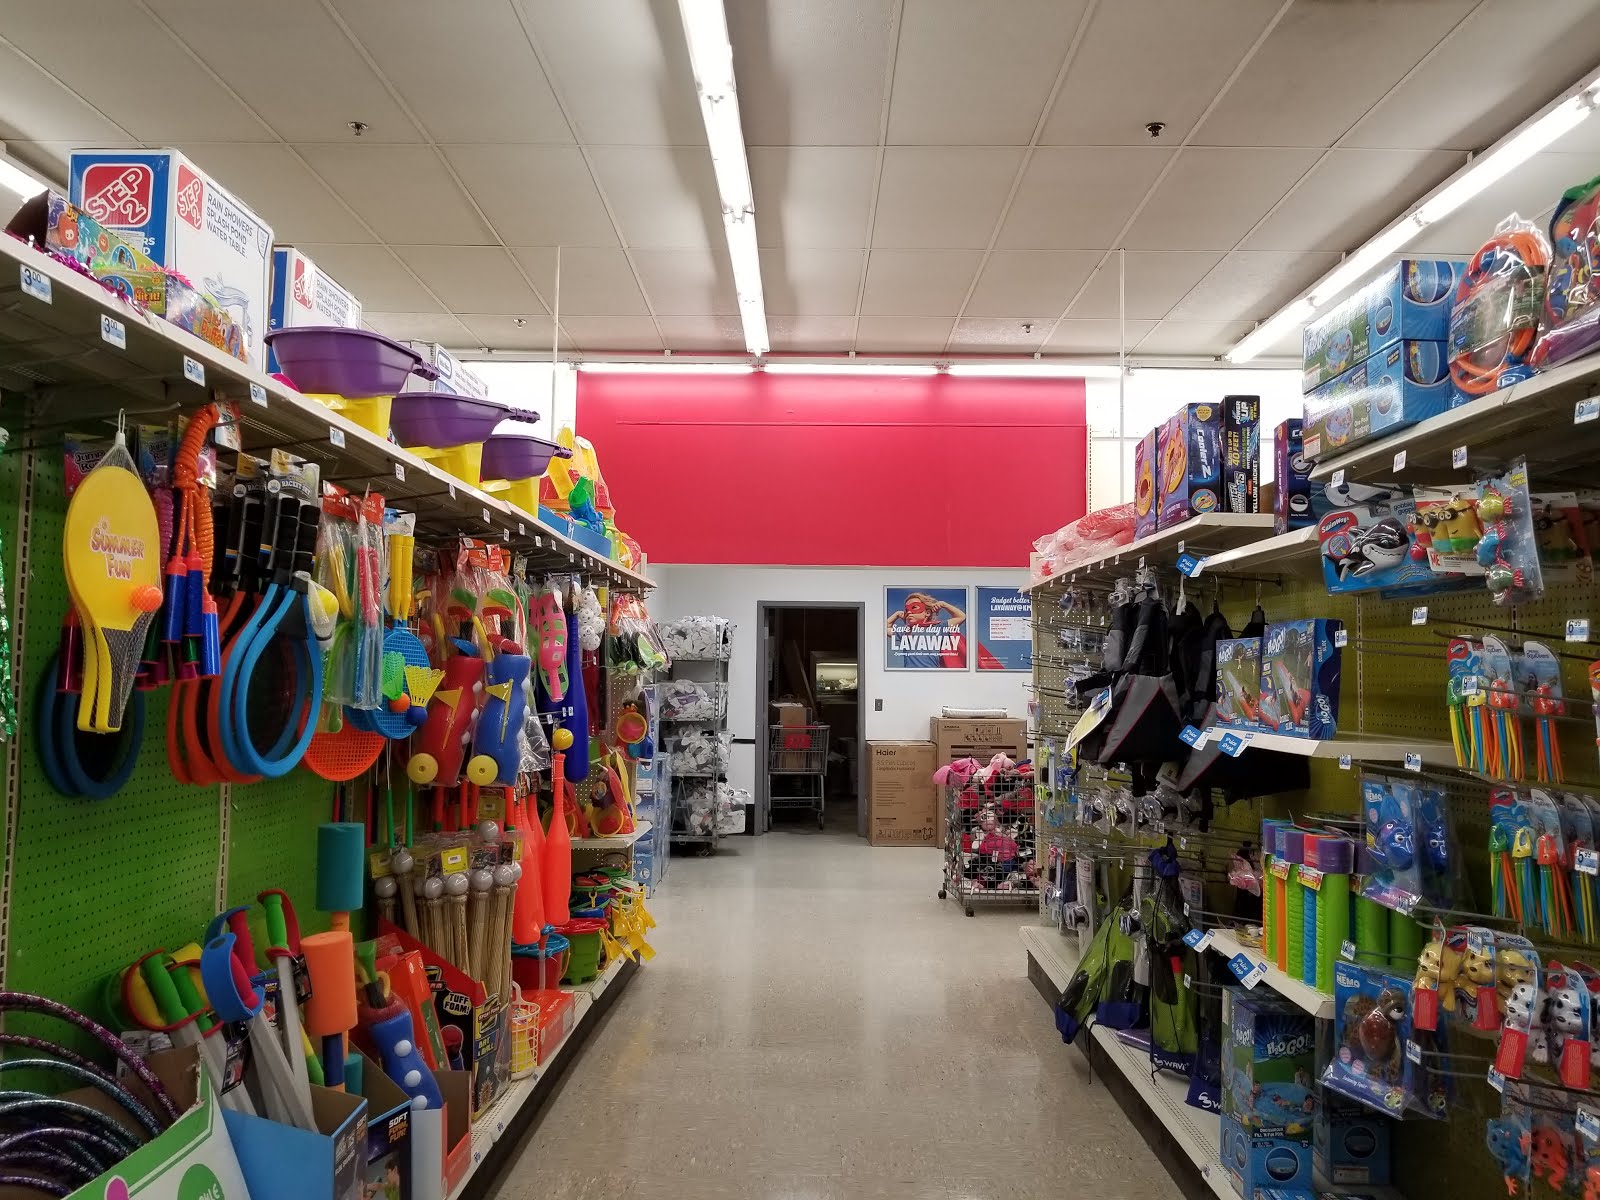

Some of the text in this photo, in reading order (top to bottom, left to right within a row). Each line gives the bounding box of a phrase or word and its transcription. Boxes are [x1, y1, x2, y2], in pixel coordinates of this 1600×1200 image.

[85, 167, 143, 222] STEP
[177, 177, 200, 218] STEP
[120, 197, 147, 223] 2
[207, 193, 253, 237] RAIN SHOWERS
[207, 206, 247, 245] SPLASH POND
[206, 219, 246, 258] WATER TABLE
[316, 290, 334, 308] SPLASH
[334, 304, 346, 319] POND
[328, 287, 349, 312] SHOWERS
[316, 300, 332, 317] WATER
[1240, 401, 1249, 417] UP
[1233, 453, 1240, 466] 40
[991, 597, 1011, 606] Budget
[892, 624, 960, 636] Save the day with
[891, 635, 961, 650] LAYAWAY
[1225, 737, 1237, 747] Price
[1337, 974, 1360, 988] NEMO
[449, 993, 470, 1005] TUFF
[444, 1001, 470, 1015] FOAM!
[389, 1112, 408, 1128] SOFT
